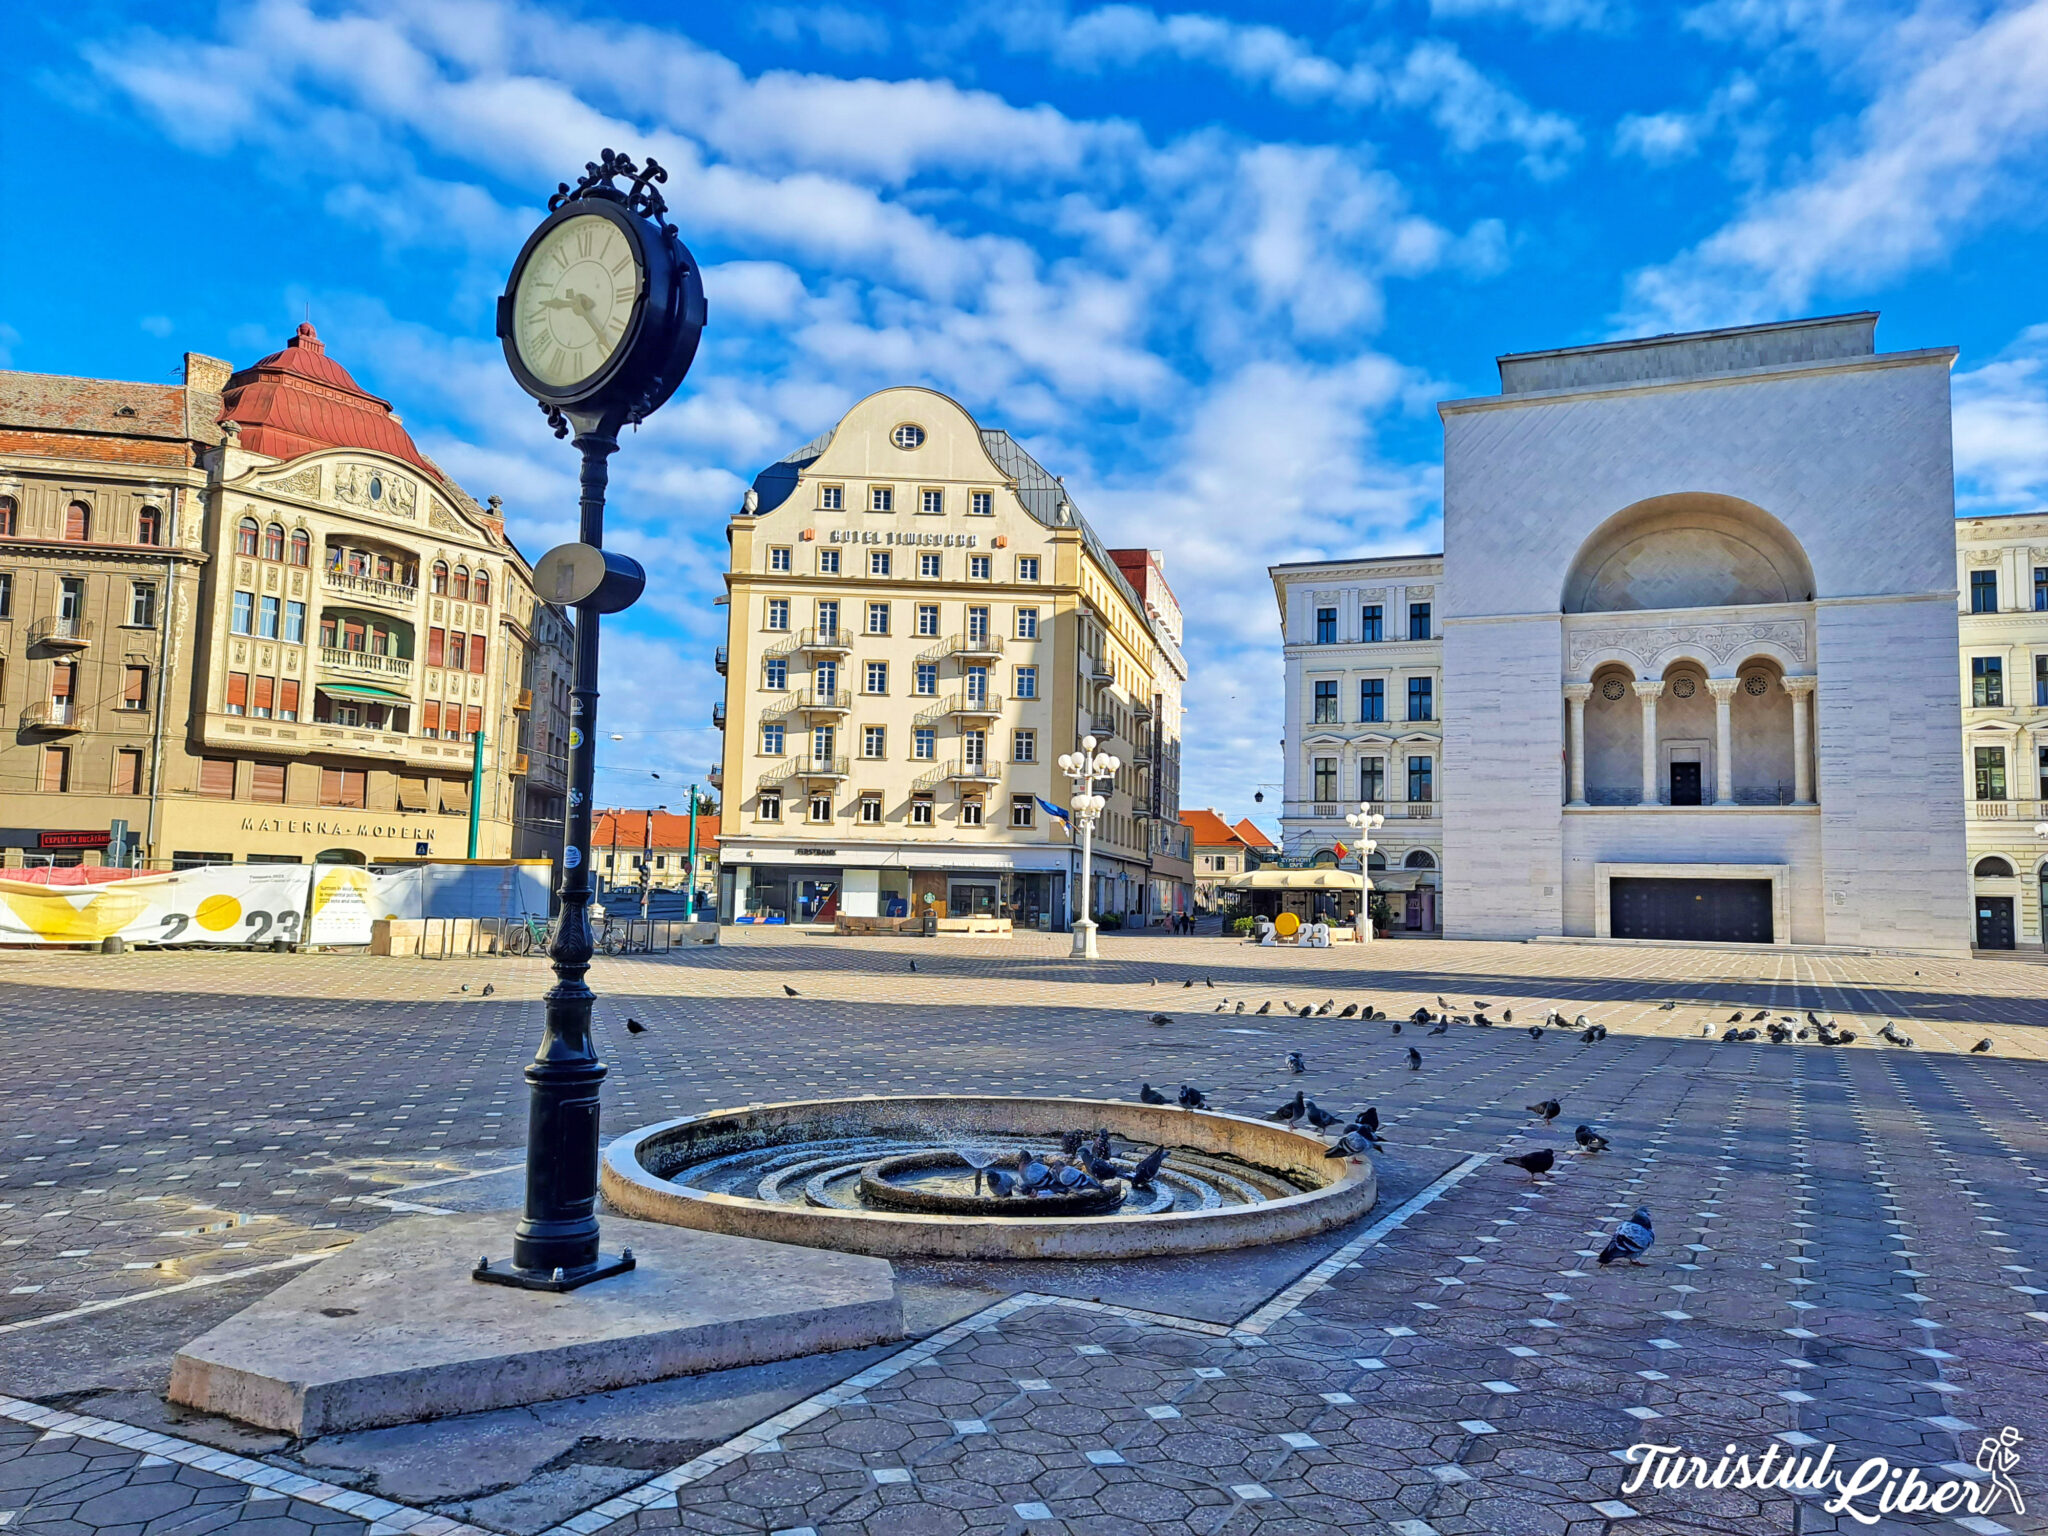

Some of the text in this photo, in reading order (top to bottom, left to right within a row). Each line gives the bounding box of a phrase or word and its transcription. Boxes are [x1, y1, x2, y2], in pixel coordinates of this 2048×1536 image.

[832, 529, 881, 544] HOTEL
[241, 818, 437, 840] MATERNA MODERN
[796, 848, 837, 856] FIRSTBANK
